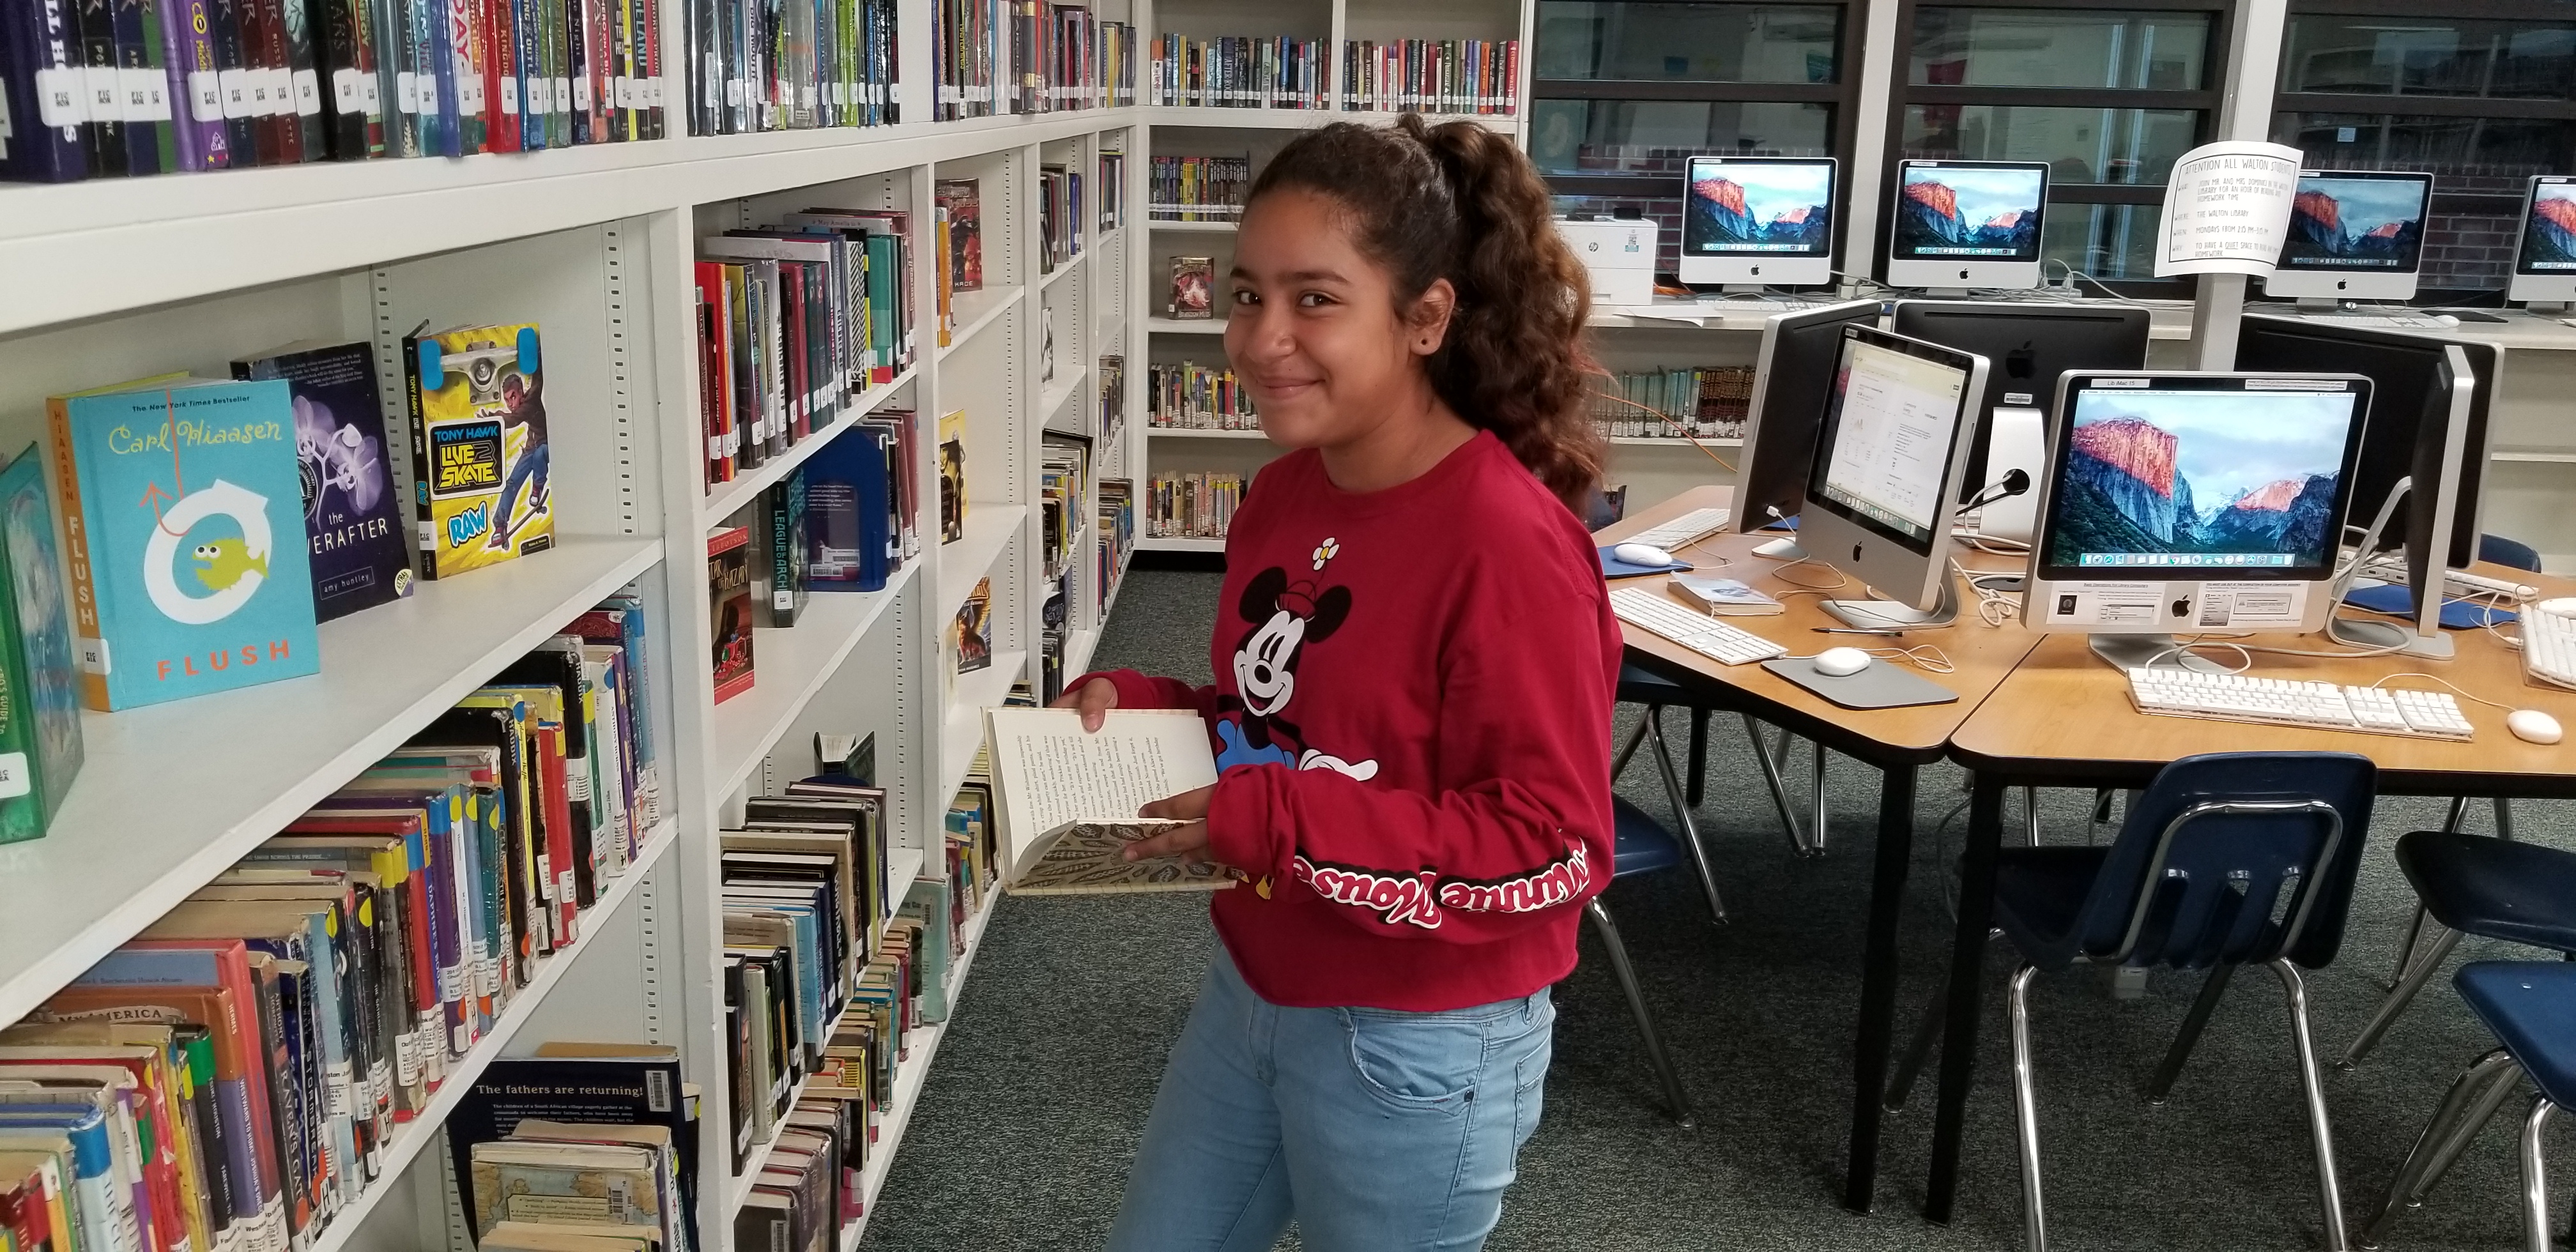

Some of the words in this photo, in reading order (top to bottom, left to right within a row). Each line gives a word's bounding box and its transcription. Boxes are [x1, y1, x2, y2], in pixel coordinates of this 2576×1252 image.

[500, 29, 509, 76] KINGDO
[602, 33, 608, 48] ON
[2185, 160, 2221, 175] ATTENTION
[2224, 158, 2237, 169] ALL
[2242, 158, 2269, 170] WALTON
[150, 403, 167, 411] New
[169, 400, 187, 409] York
[189, 399, 211, 408] Times
[213, 396, 250, 404] Bestseller
[109, 422, 171, 455] Carl
[176, 419, 282, 447] Hiaasen
[434, 429, 464, 443] TONY
[466, 425, 498, 441] HAWK
[54, 411, 74, 501] HIAASEN
[441, 445, 475, 467] LIVE
[416, 480, 428, 506] RAW
[440, 462, 498, 490] SKATE
[307, 518, 388, 555] ERAFTER
[328, 512, 344, 525] the
[448, 501, 487, 547] RAW
[775, 510, 786, 551] LEAGUE
[68, 515, 94, 626] FLUSH
[324, 583, 338, 594] amy
[342, 574, 370, 588] huntley
[709, 559, 723, 580] TAR
[724, 565, 748, 590] KAZAN
[777, 559, 788, 591] ARCH
[157, 639, 290, 681] FLUSH
[509, 719, 518, 767] HADDIX
[1292, 854, 1442, 929] Mouse
[1440, 835, 1590, 913] Minnie
[427, 884, 439, 950] DAPHNE'S
[434, 952, 443, 988] BOOK
[227, 1004, 238, 1035] HERMES
[275, 992, 284, 1040] ANTHONY
[476, 1085, 501, 1095] The
[506, 1085, 550, 1095] fathers
[555, 1086, 574, 1095] are
[579, 1086, 644, 1098] returning!
[212, 1103, 221, 1139] HOUSTON
[280, 1071, 298, 1151] RAVEN'S
[238, 1078, 250, 1122] WESTWARD
[245, 1122, 252, 1132] TO
[250, 1157, 261, 1192] JOSHUA'S
[221, 1165, 231, 1202] FAREWELL
[226, 1203, 232, 1214] TO
